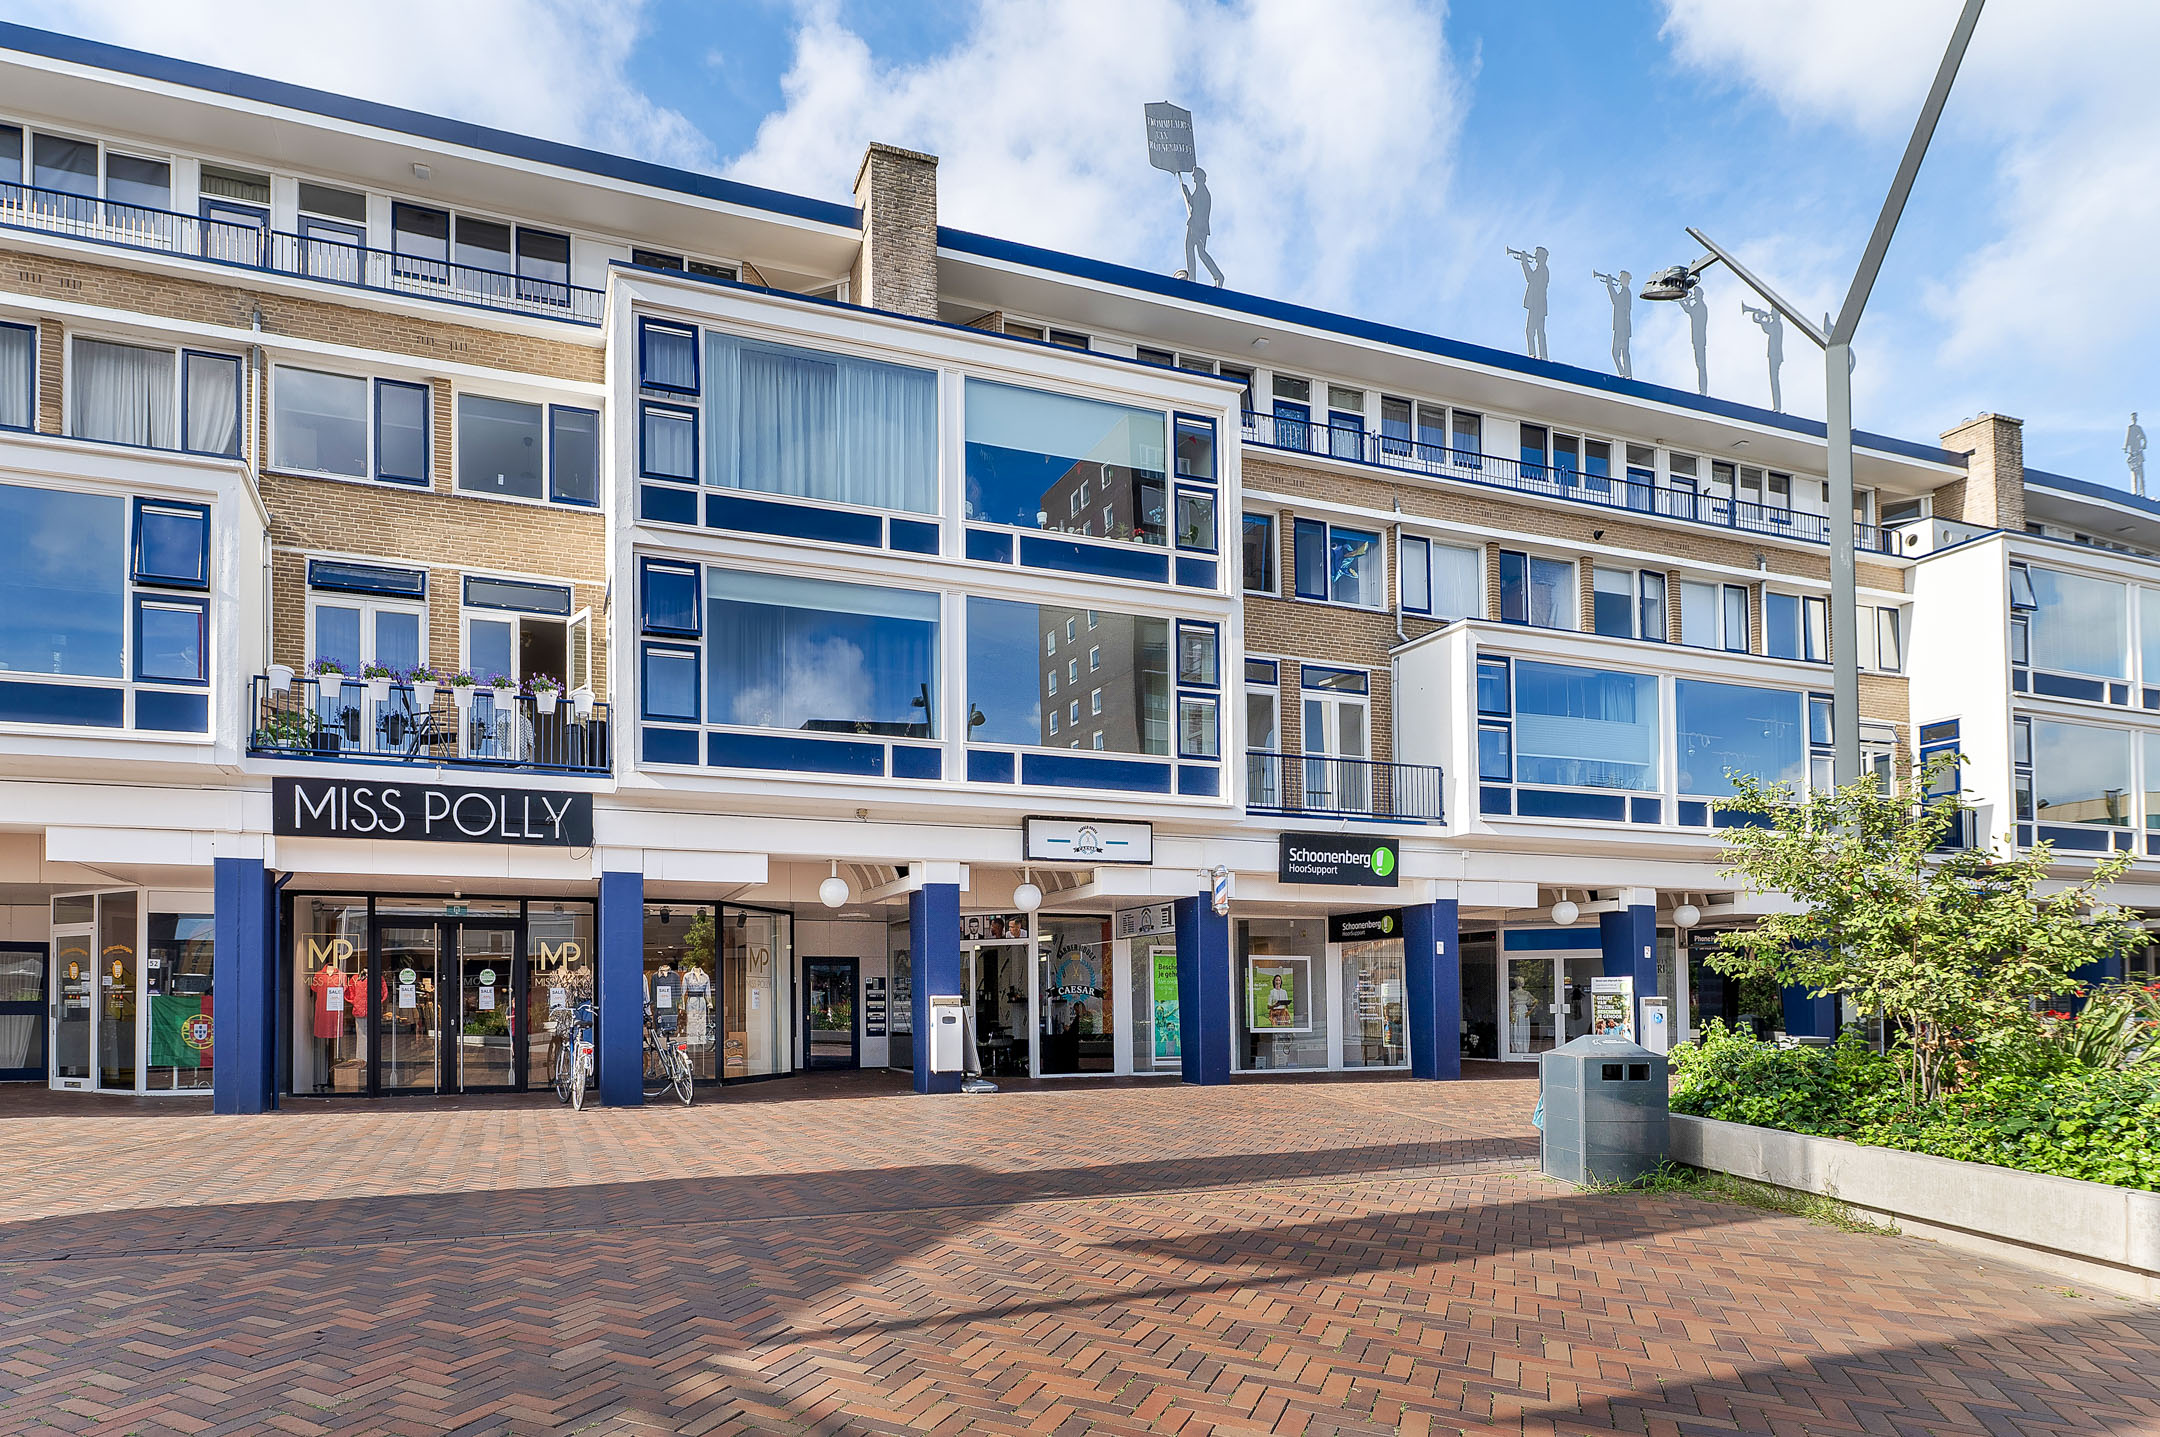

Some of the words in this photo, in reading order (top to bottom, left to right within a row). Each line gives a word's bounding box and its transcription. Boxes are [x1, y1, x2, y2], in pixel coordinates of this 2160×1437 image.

[293, 784, 406, 834] MISS
[424, 790, 573, 840] POLLY
[1289, 847, 1371, 868] Schoonenberg
[1289, 863, 1338, 876] HoorSupport
[1342, 919, 1382, 931] Schoonenberg
[308, 938, 354, 969] MP
[540, 941, 581, 971] MP
[749, 947, 769, 973] MP
[301, 976, 324, 987] MISS
[1058, 985, 1095, 996] CAESAR
